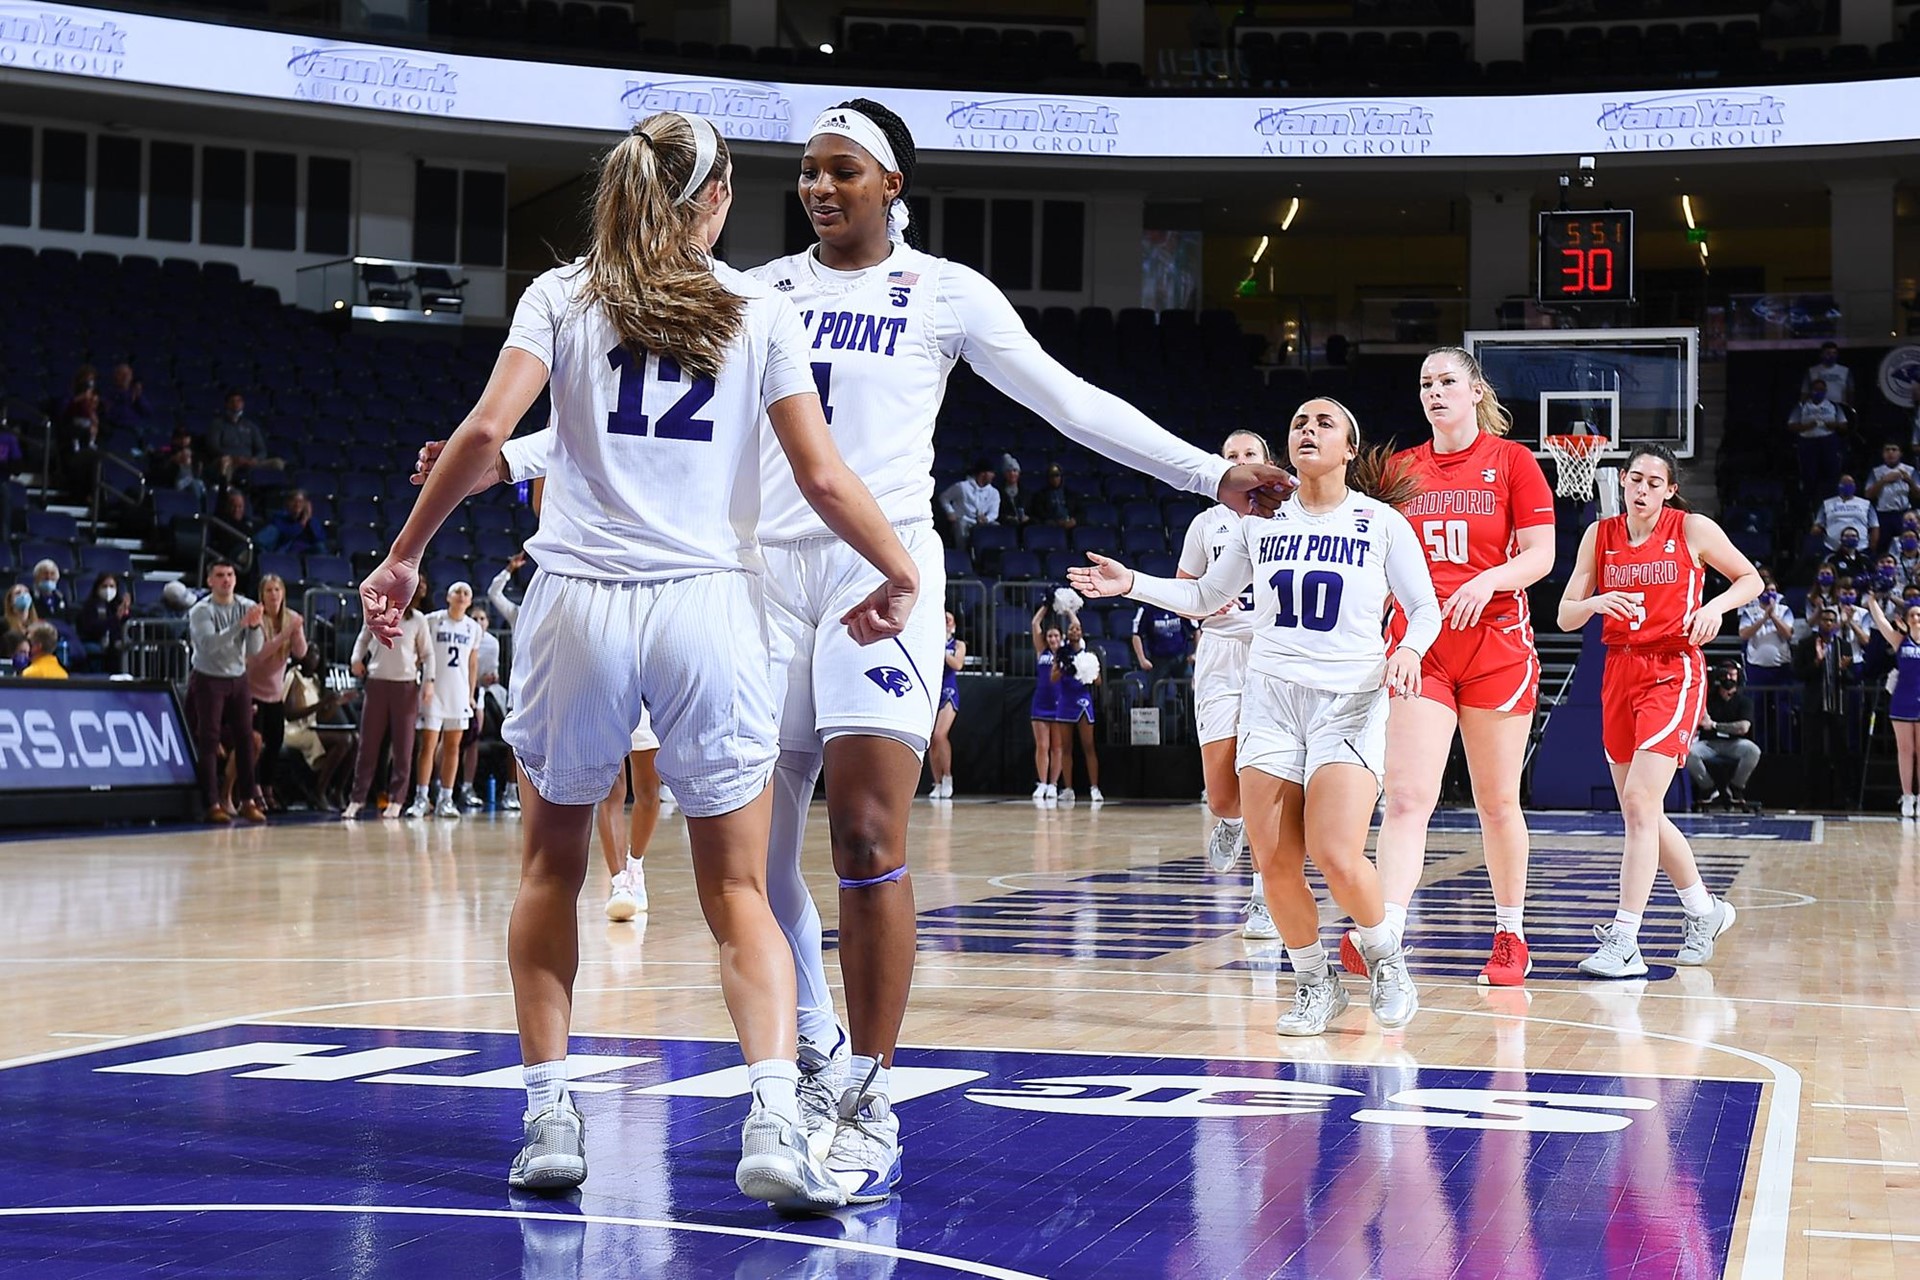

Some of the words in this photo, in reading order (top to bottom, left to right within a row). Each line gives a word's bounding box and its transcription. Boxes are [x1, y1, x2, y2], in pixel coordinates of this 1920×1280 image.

[33, 49, 124, 77] GROUP
[294, 82, 358, 103] AUTO
[373, 90, 456, 113] GROUP
[713, 120, 789, 141] ROUP
[953, 133, 1018, 150] AUTO
[1032, 135, 1117, 153] GROUP
[1605, 132, 1674, 150] AUTO
[1690, 128, 1782, 148] GROUP
[1261, 139, 1328, 155] AUTO
[1343, 138, 1431, 155] GROUP
[1562, 248, 1613, 292] 30
[811, 310, 908, 357] POINT
[606, 337, 717, 442] 12
[1258, 535, 1302, 564] HIGH
[1304, 535, 1370, 567] POINT
[1423, 520, 1469, 564] 50
[1268, 569, 1344, 632] 10
[447, 646, 459, 667] 2
